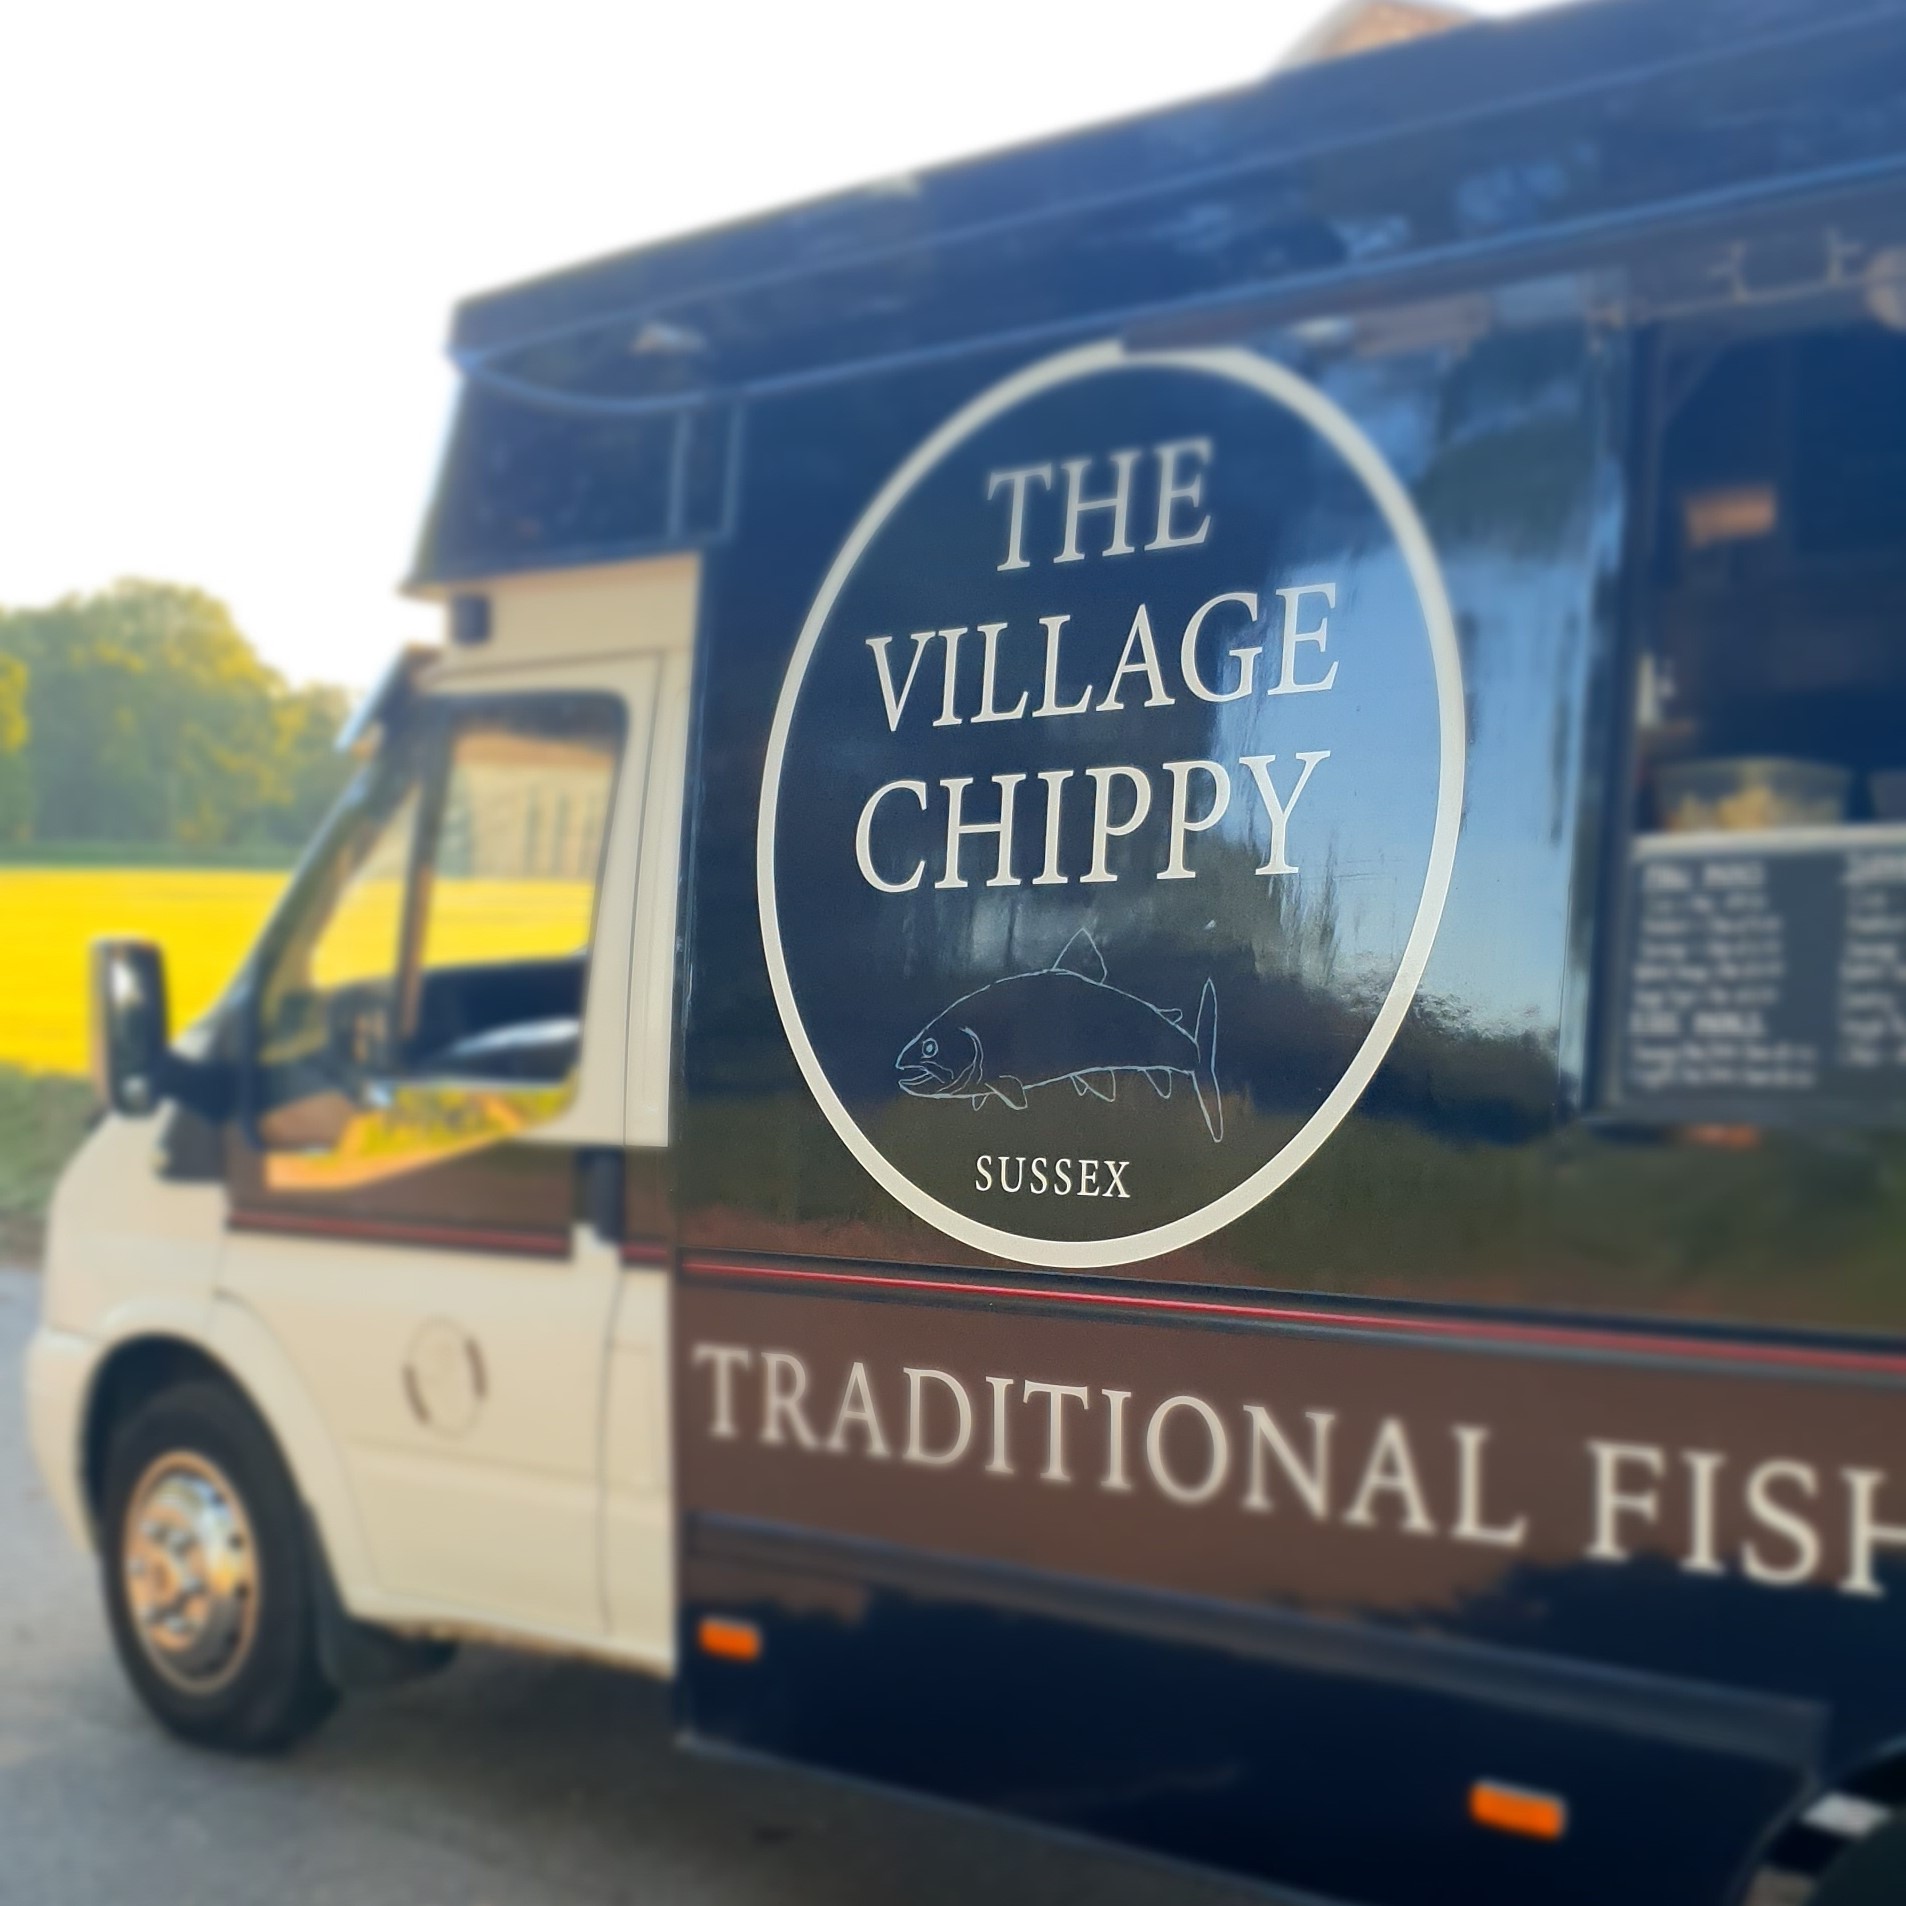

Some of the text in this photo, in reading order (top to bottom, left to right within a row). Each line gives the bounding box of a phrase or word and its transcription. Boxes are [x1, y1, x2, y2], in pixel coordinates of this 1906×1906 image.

[987, 439, 1212, 571] THE
[864, 583, 1339, 732] VILLAGE
[855, 750, 1330, 893] CHIPPY
[974, 1155, 1131, 1199] SUSSEX
[693, 1341, 1527, 1547] TRADITIONAL
